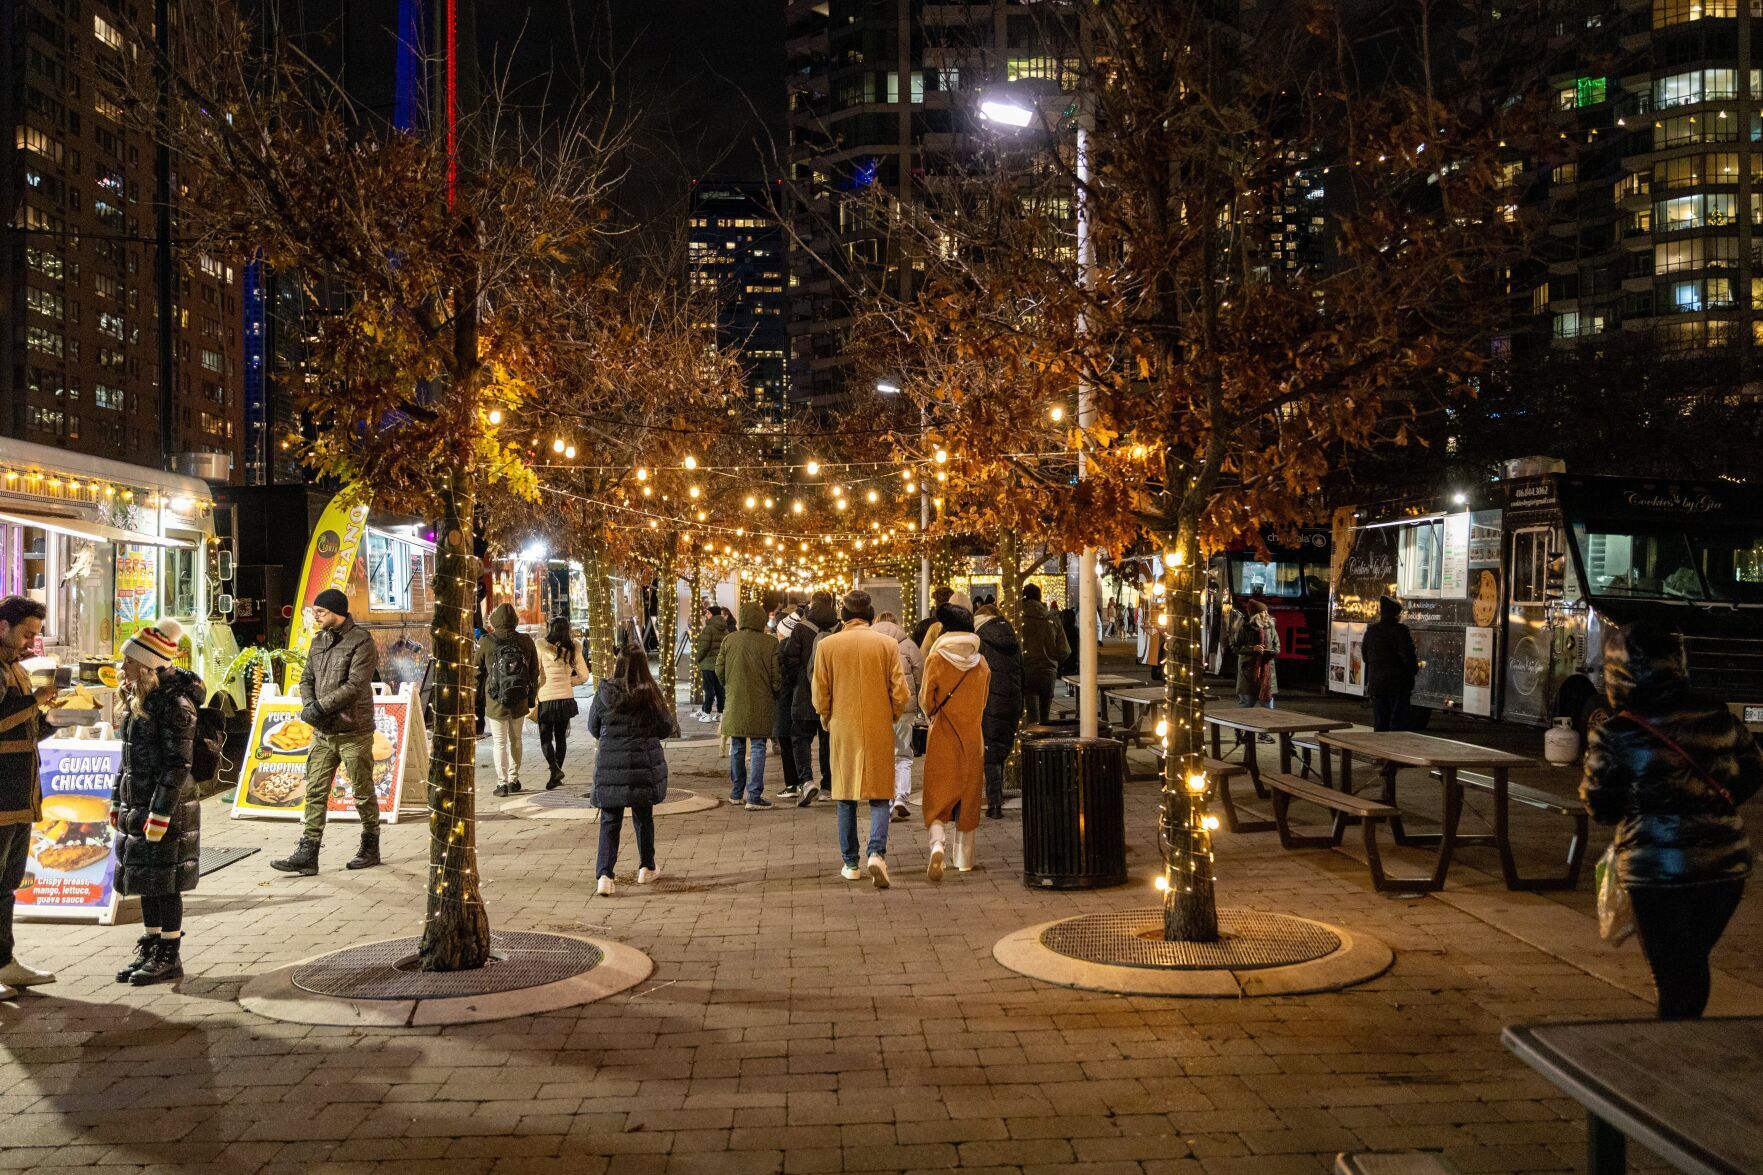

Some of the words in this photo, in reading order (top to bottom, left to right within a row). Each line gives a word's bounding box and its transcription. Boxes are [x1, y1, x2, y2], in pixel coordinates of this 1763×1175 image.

[59, 756, 112, 774] GUAVA
[51, 774, 115, 791] CHICKEN
[38, 877, 62, 886] Crispy
[64, 877, 90, 886] breast,
[33, 887, 60, 896] mango,
[62, 886, 91, 895] lettuce,
[36, 897, 60, 905] guava
